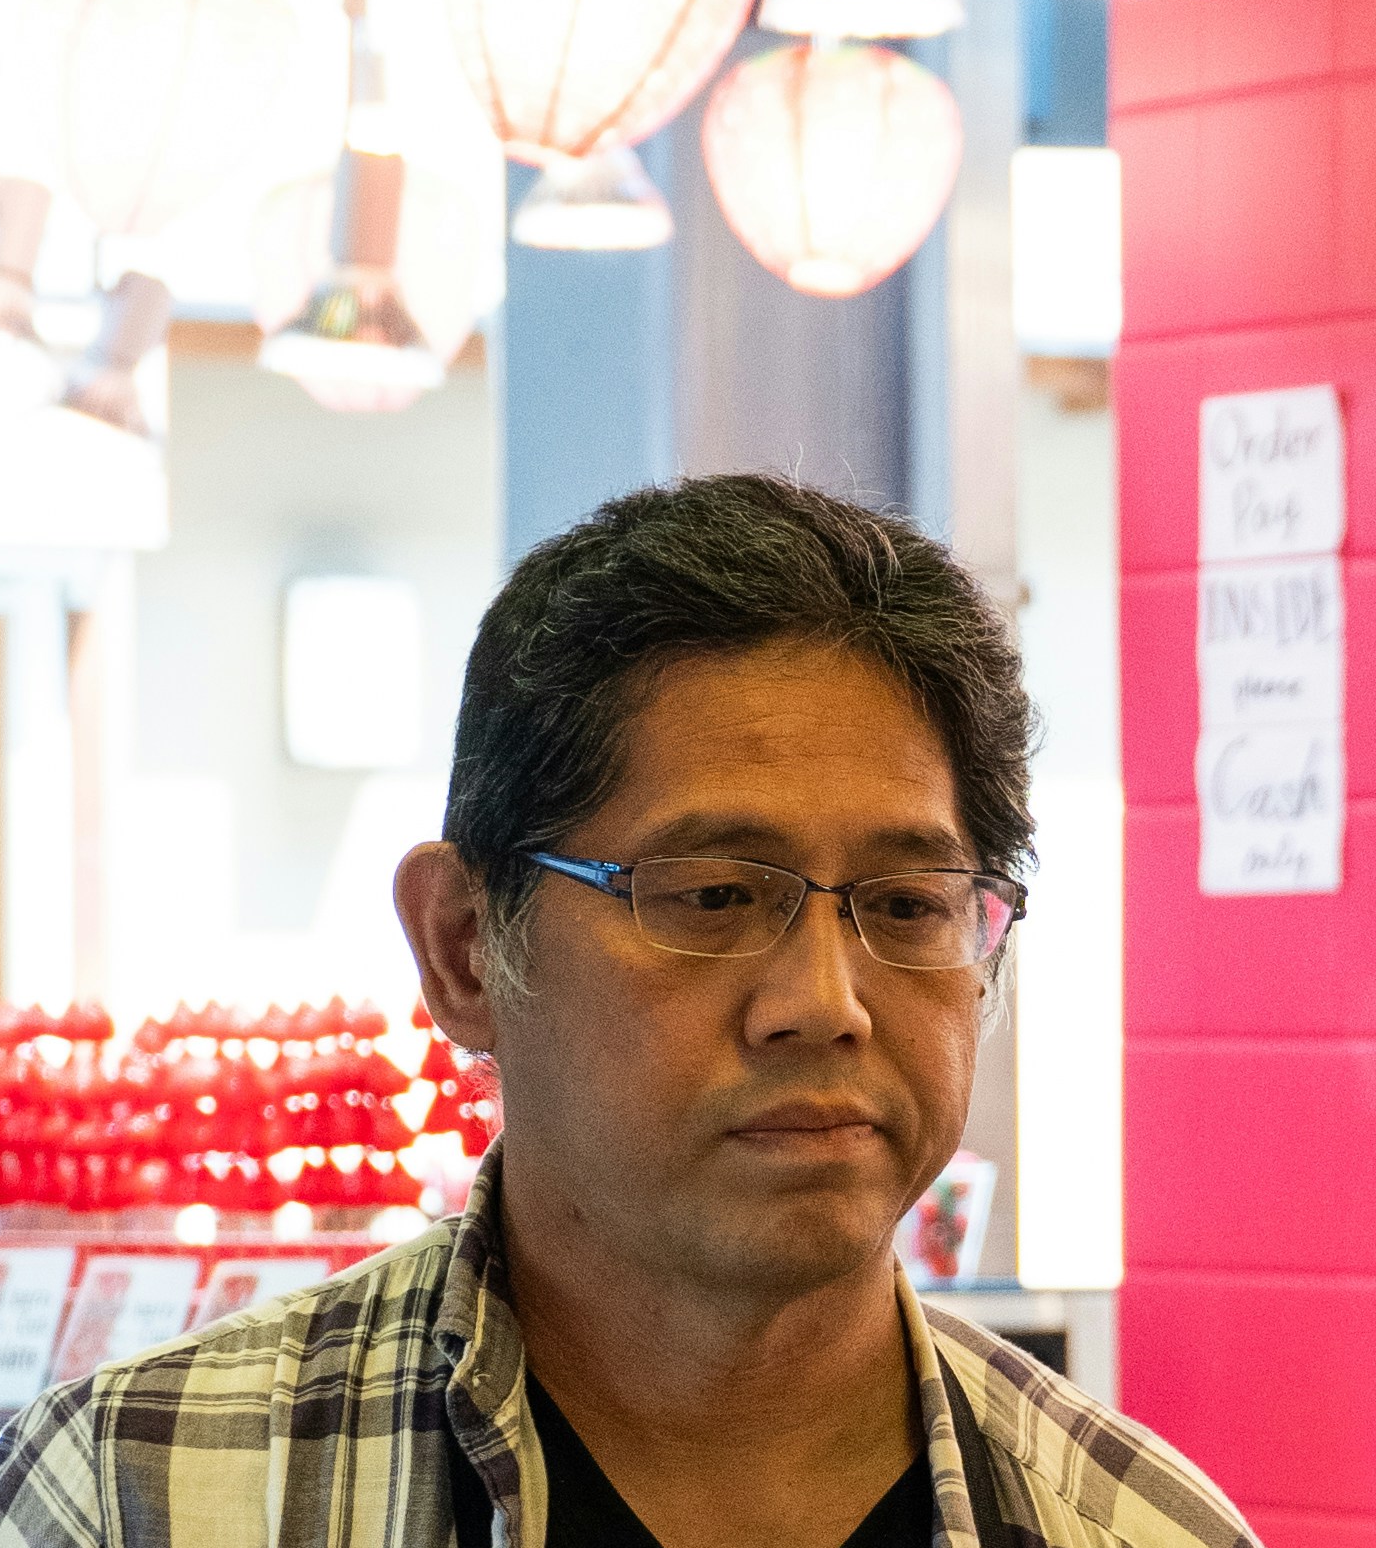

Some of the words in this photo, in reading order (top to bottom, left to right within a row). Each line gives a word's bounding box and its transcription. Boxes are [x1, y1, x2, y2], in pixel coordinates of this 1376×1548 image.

[1210, 404, 1321, 472] Order
[1232, 476, 1301, 542] Pay
[1203, 572, 1336, 646] INSIDE
[1209, 734, 1328, 824] Cash
